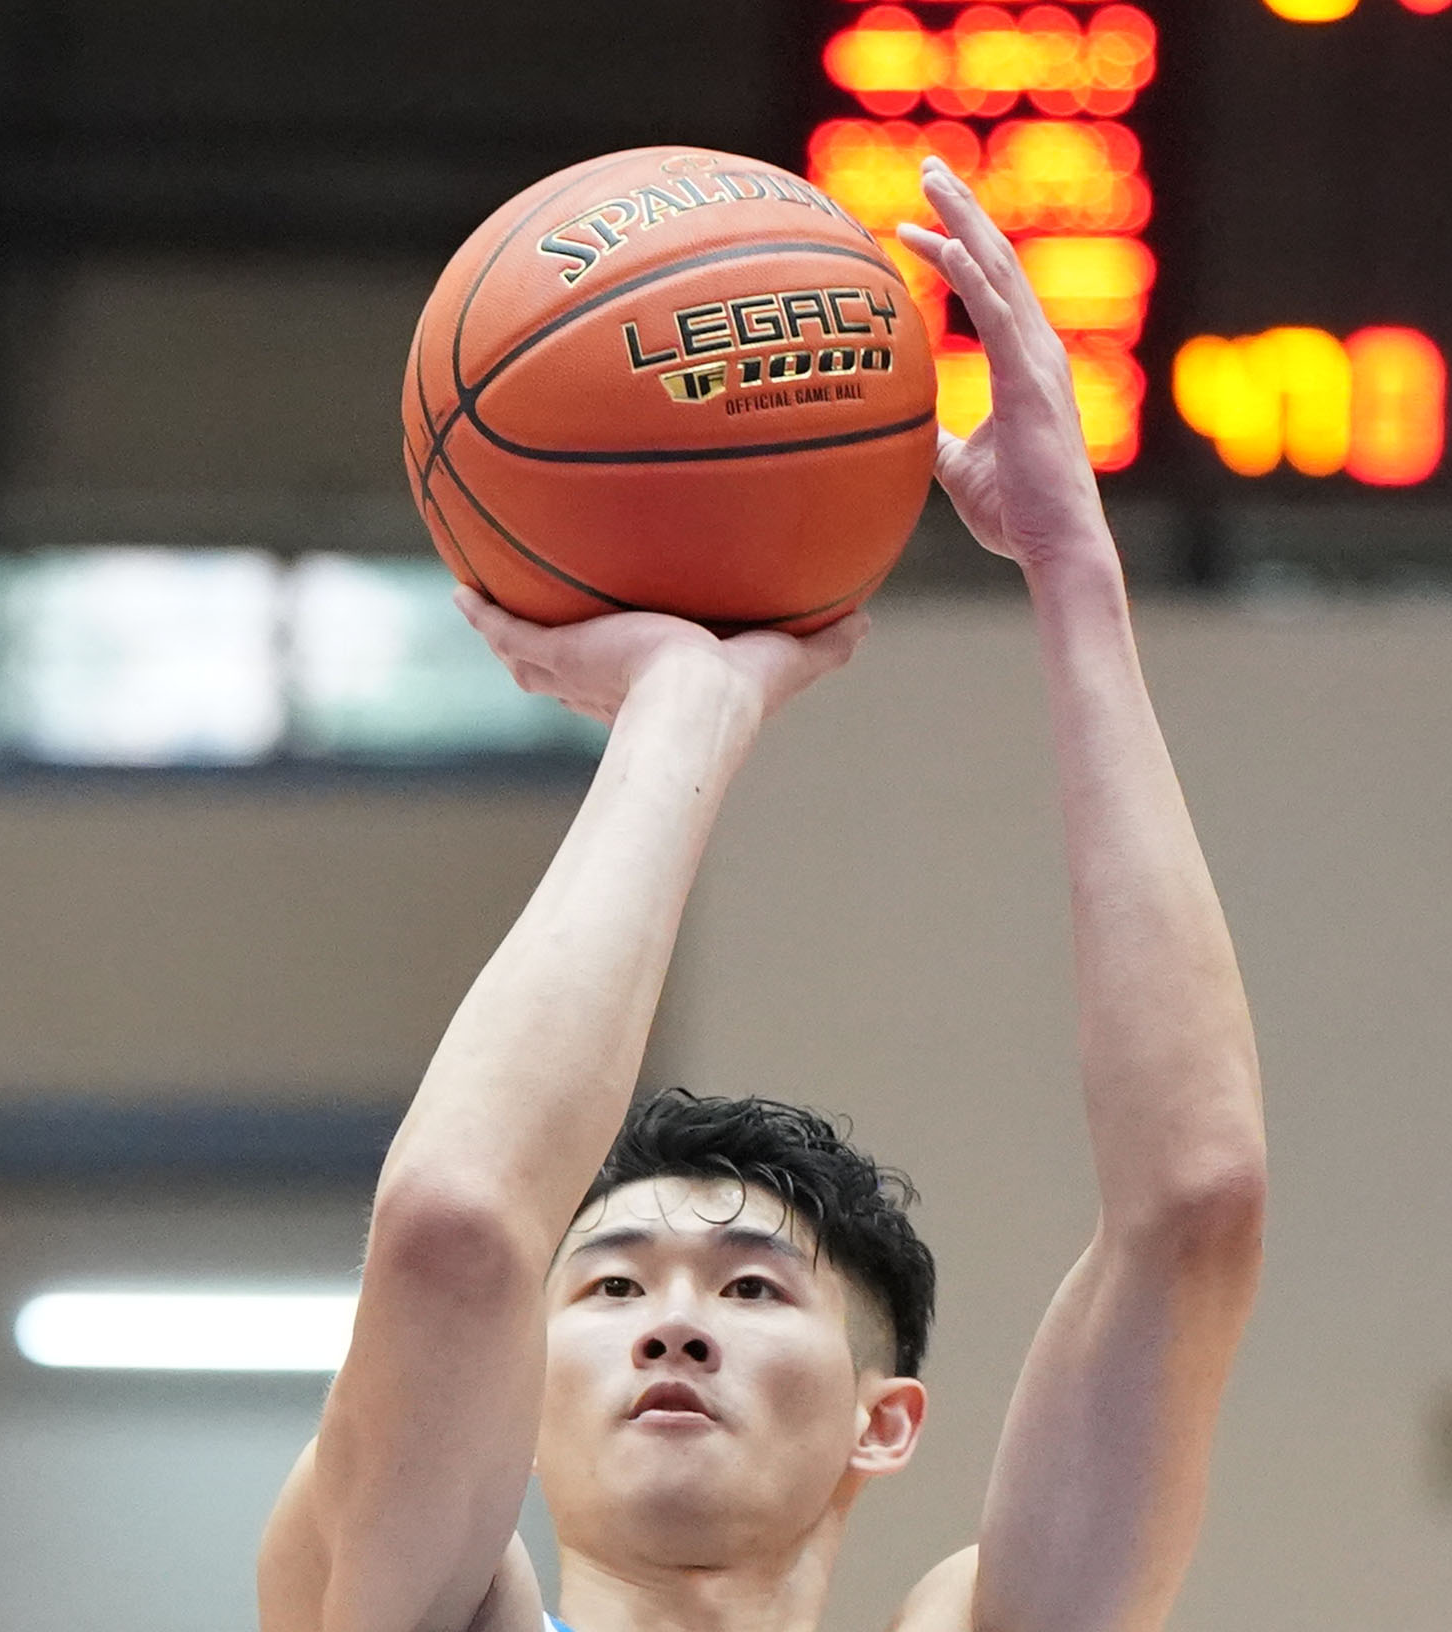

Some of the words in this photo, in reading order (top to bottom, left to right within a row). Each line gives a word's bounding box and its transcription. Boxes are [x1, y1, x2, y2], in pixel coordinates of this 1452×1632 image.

[621, 287, 898, 373] LEGACY
[726, 390, 792, 416] OFFICIAL
[795, 386, 831, 405] GAME
[835, 383, 865, 400] BALL
